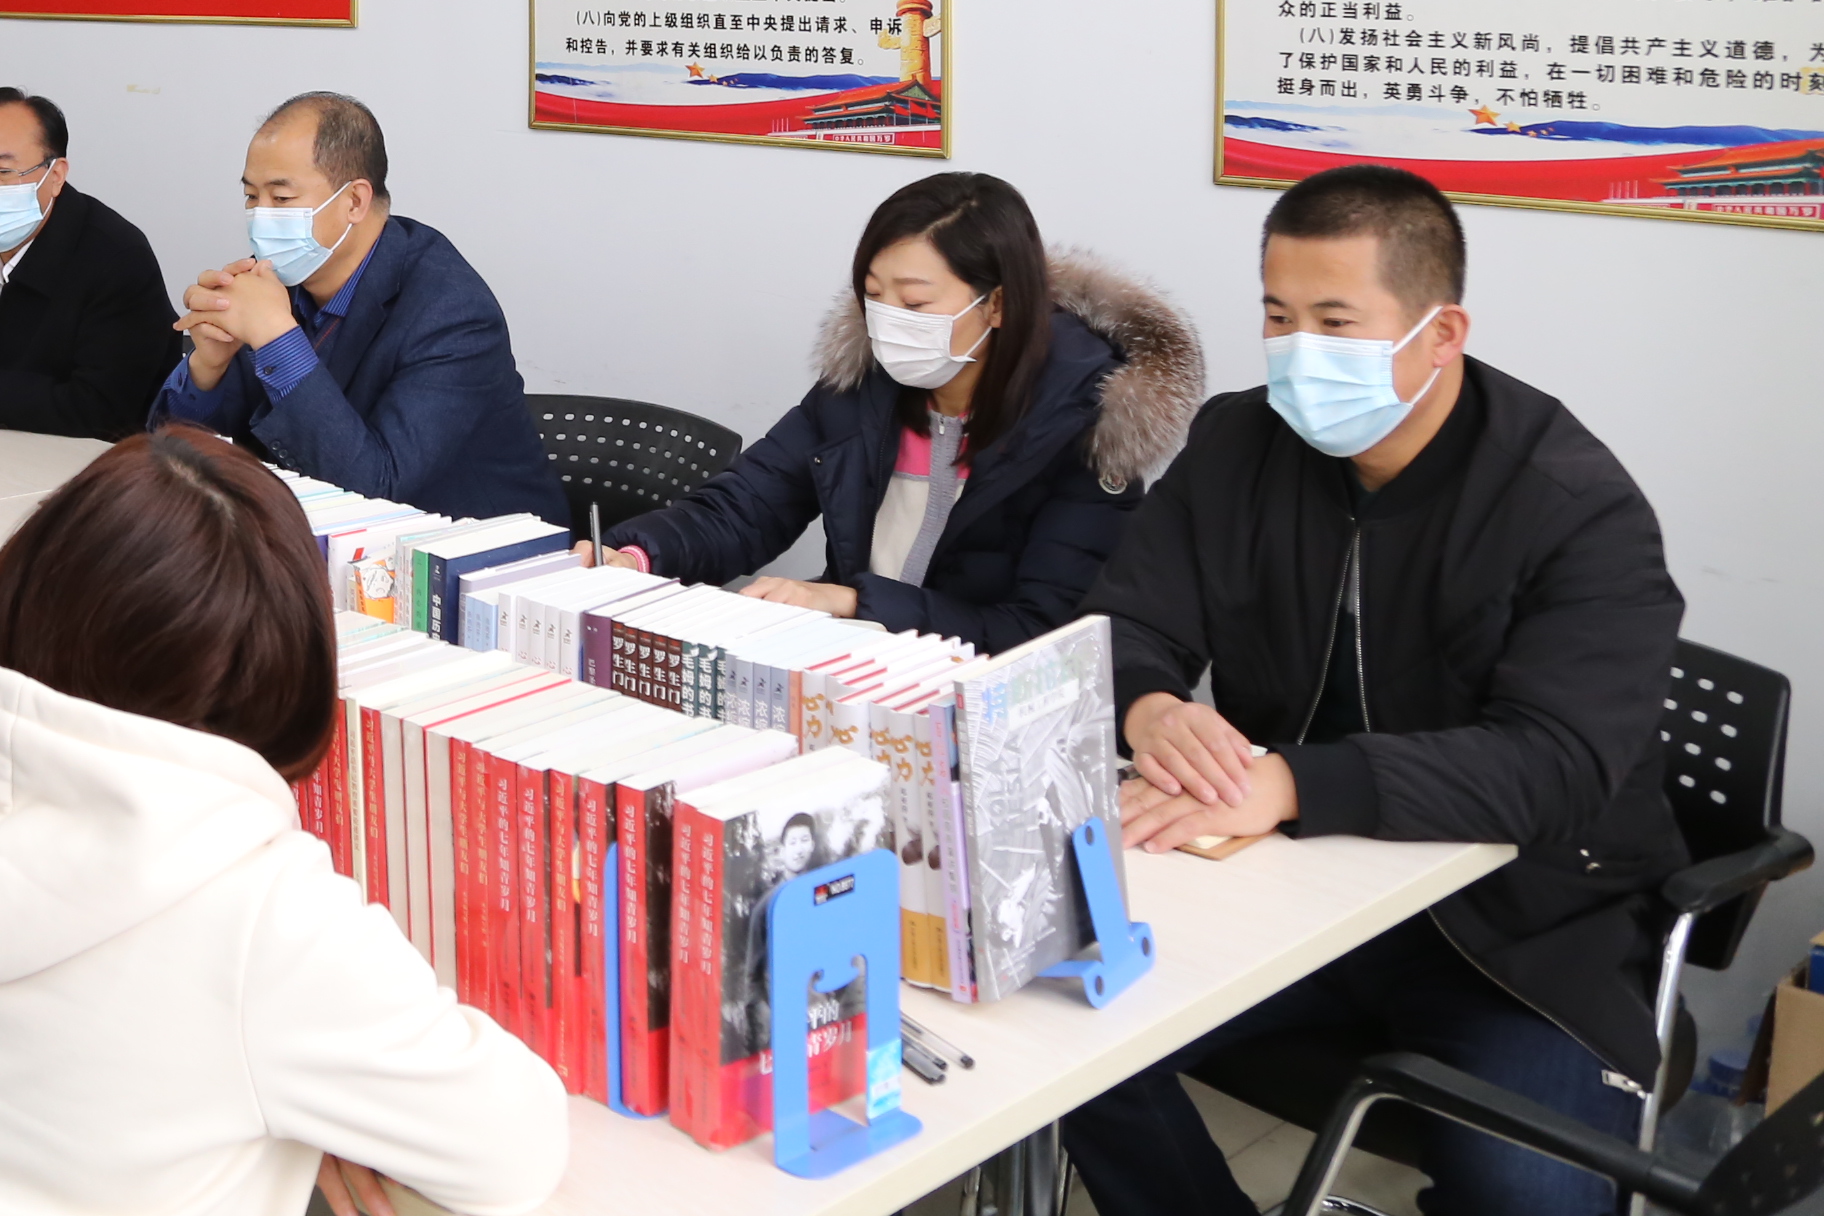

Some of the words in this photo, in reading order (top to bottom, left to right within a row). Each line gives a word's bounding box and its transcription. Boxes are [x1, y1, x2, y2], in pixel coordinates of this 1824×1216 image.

[1277, 0, 1415, 22] 众的正当利益。
[565, 36, 864, 66] 和控告，并要求有关组织给以负责的答复。
[612, 636, 625, 686] 罗生门
[625, 641, 637, 692] 罗生门
[639, 645, 652, 696] 罗生门
[654, 649, 667, 700] 罗生门
[668, 653, 682, 705] 罗生门
[497, 777, 510, 912] 习近平的七年知青岁月
[523, 788, 537, 924] 习近平的七年知青岁月
[586, 799, 599, 937] 习近平的七年知青岁月
[623, 804, 637, 945] 习近平的七年知青岁月
[678, 824, 692, 965] 习近平的七年知青岁月
[701, 832, 714, 976] 习近平的七年知青岁月
